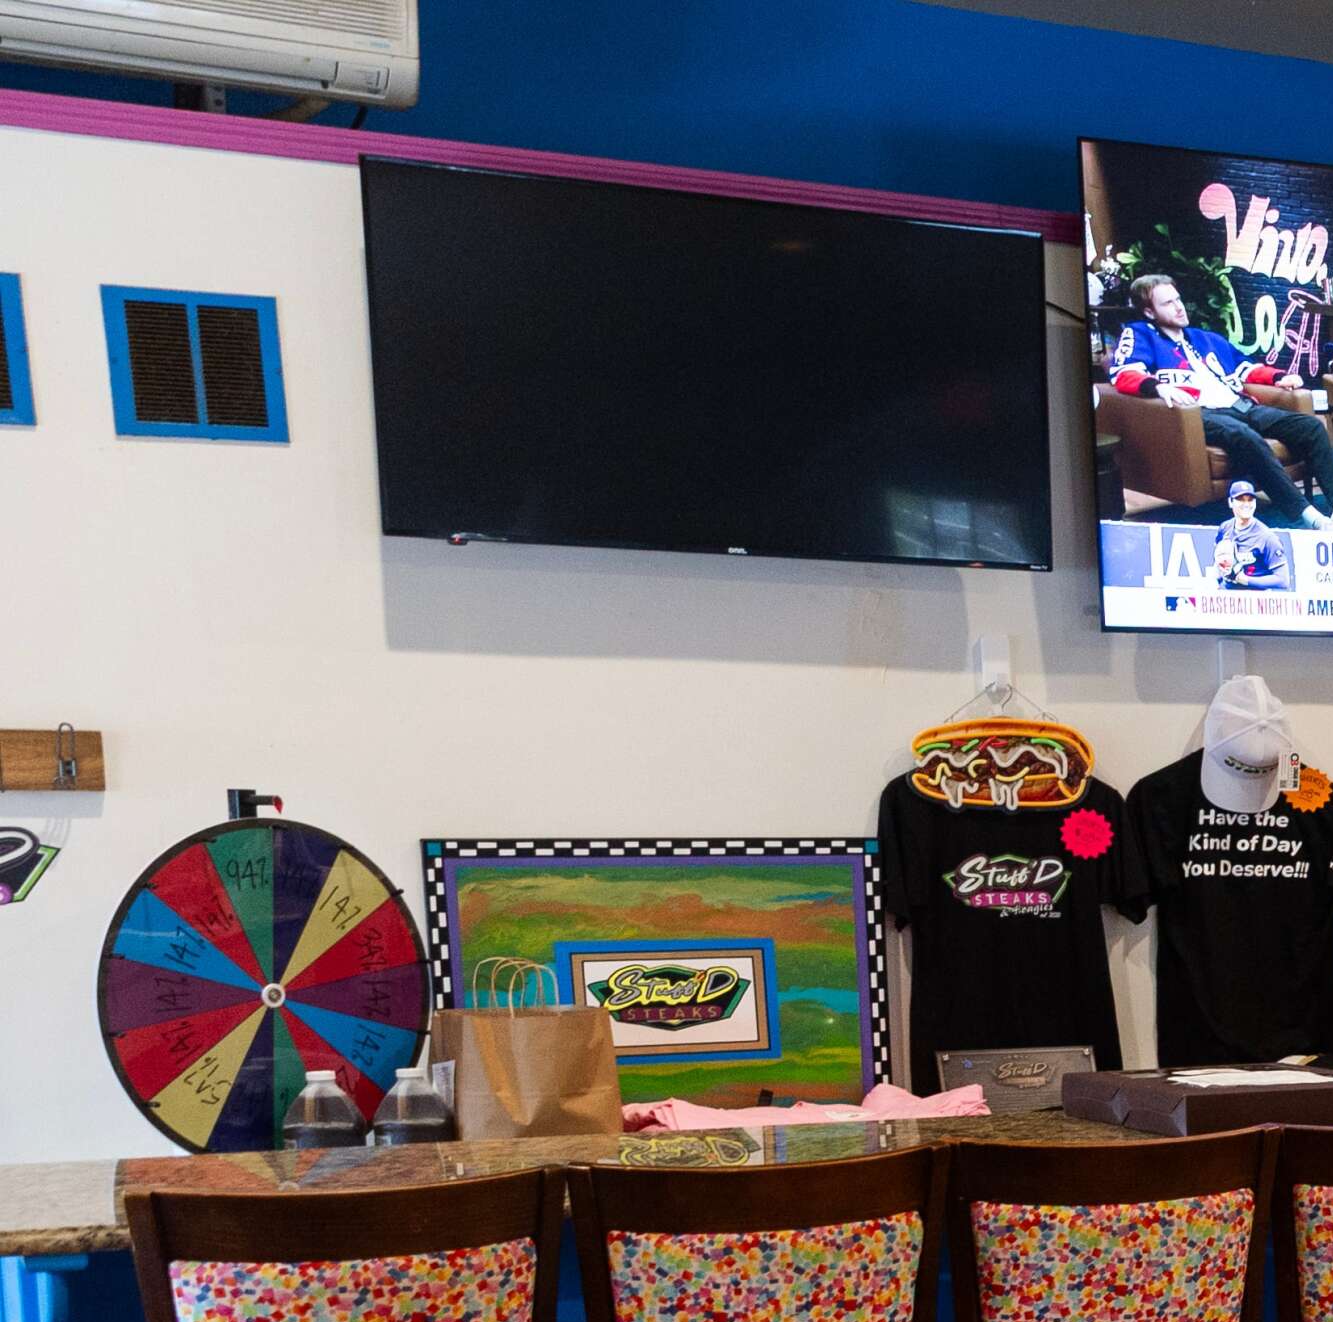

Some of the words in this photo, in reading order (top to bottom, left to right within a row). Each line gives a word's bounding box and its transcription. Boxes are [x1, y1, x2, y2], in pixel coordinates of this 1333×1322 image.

[1201, 596, 1254, 615] BASEBALL
[1257, 598, 1289, 617] NIGHT
[1291, 599, 1303, 617] IN
[1198, 809, 1250, 826] Have
[1254, 811, 1290, 828] the
[1188, 833, 1232, 852] Kind
[1236, 834, 1260, 852] of
[1262, 835, 1303, 857] Day
[1182, 860, 1216, 878] You
[1219, 859, 1310, 879] Deserve!!!
[973, 891, 1049, 907] STEAKS
[626, 1006, 718, 1022] STEAKS
